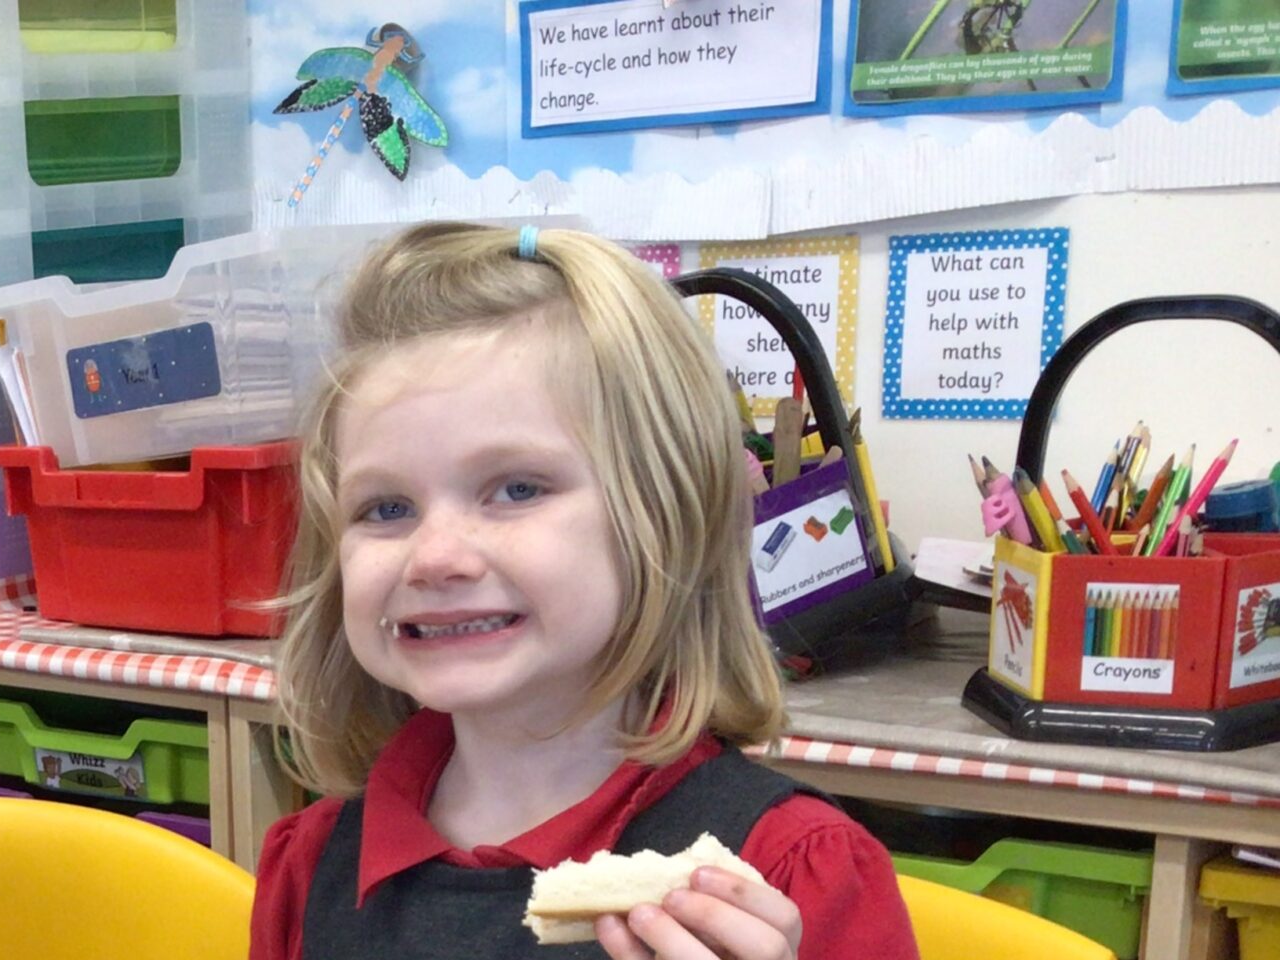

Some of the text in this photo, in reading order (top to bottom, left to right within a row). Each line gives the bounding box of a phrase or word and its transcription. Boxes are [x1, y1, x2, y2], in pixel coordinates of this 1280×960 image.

[540, 5, 774, 45] We have learnt about their
[540, 42, 737, 79] life-cycle and how they
[540, 91, 599, 112] change.
[754, 264, 822, 285] timate
[931, 254, 1024, 273] What can
[926, 284, 1026, 308] you use to
[928, 311, 1019, 336] help with
[942, 341, 1002, 360] maths
[734, 365, 777, 386] here
[938, 370, 1004, 394] today?
[760, 554, 865, 604] Rubbers and sharpeners
[1093, 661, 1161, 682] Crayons
